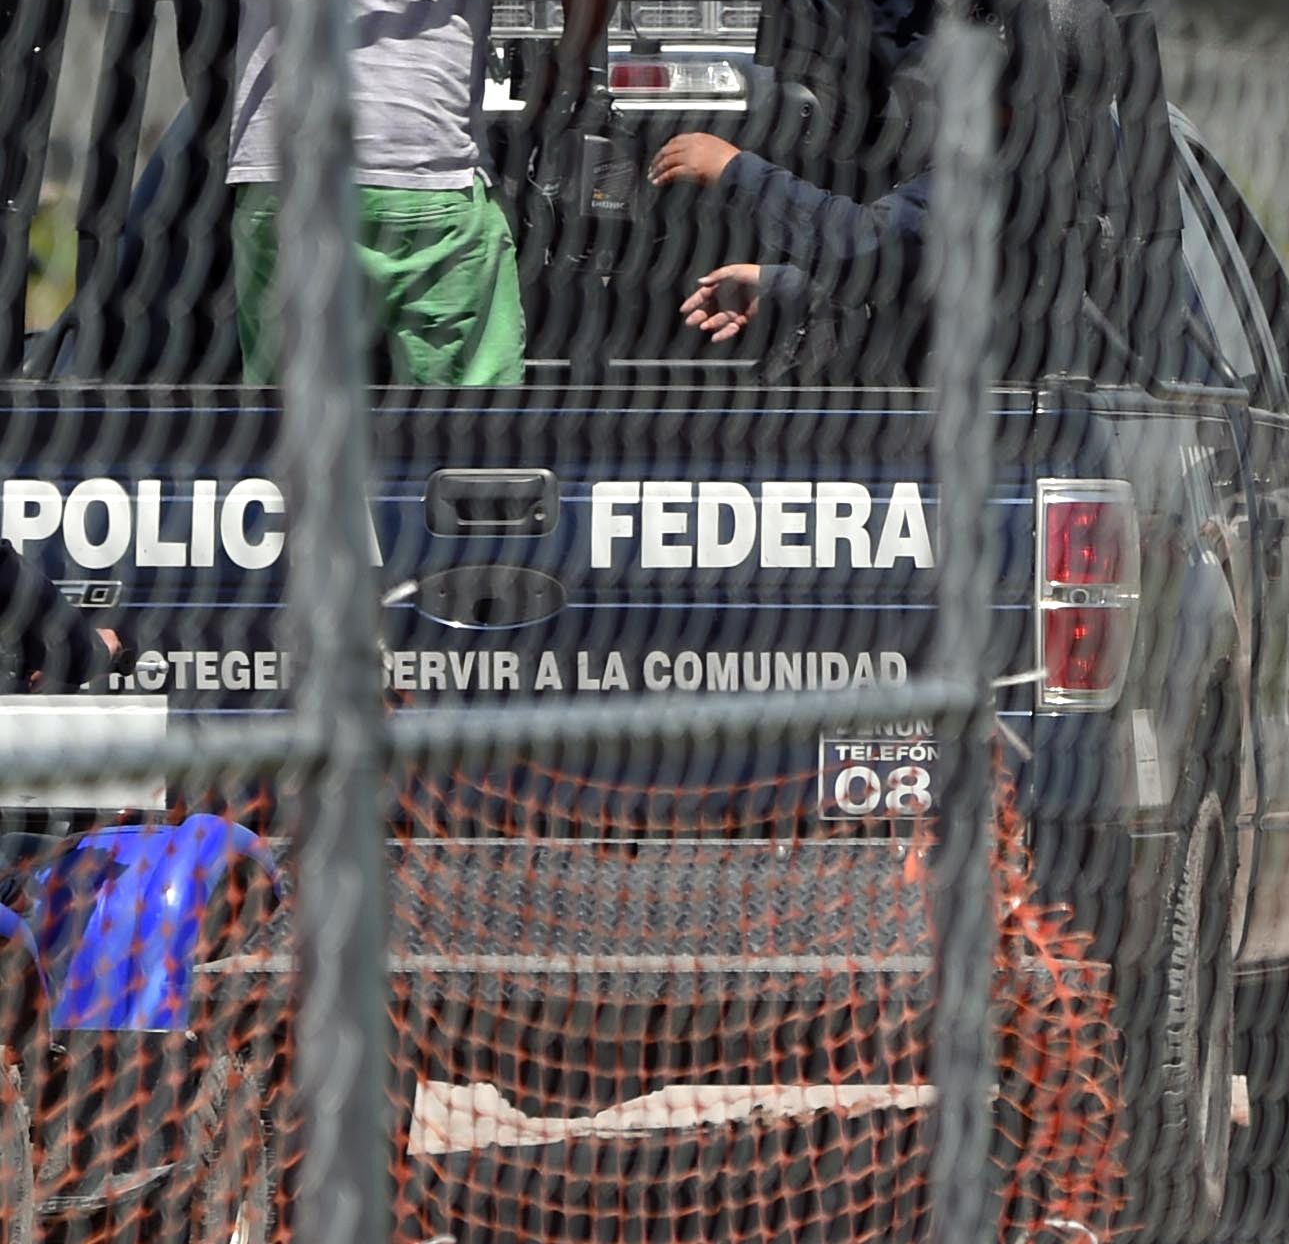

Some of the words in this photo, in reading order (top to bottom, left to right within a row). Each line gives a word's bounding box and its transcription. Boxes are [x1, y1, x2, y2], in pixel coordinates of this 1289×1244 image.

[2, 478, 384, 570] POLIC
[591, 481, 942, 569] FEDERA
[80, 651, 293, 690] OTEGE
[534, 651, 563, 691] A
[577, 651, 629, 691] LA
[643, 651, 908, 692] COMUNIDAD
[834, 741, 940, 762] TELEFÓN
[834, 765, 933, 816] 08
